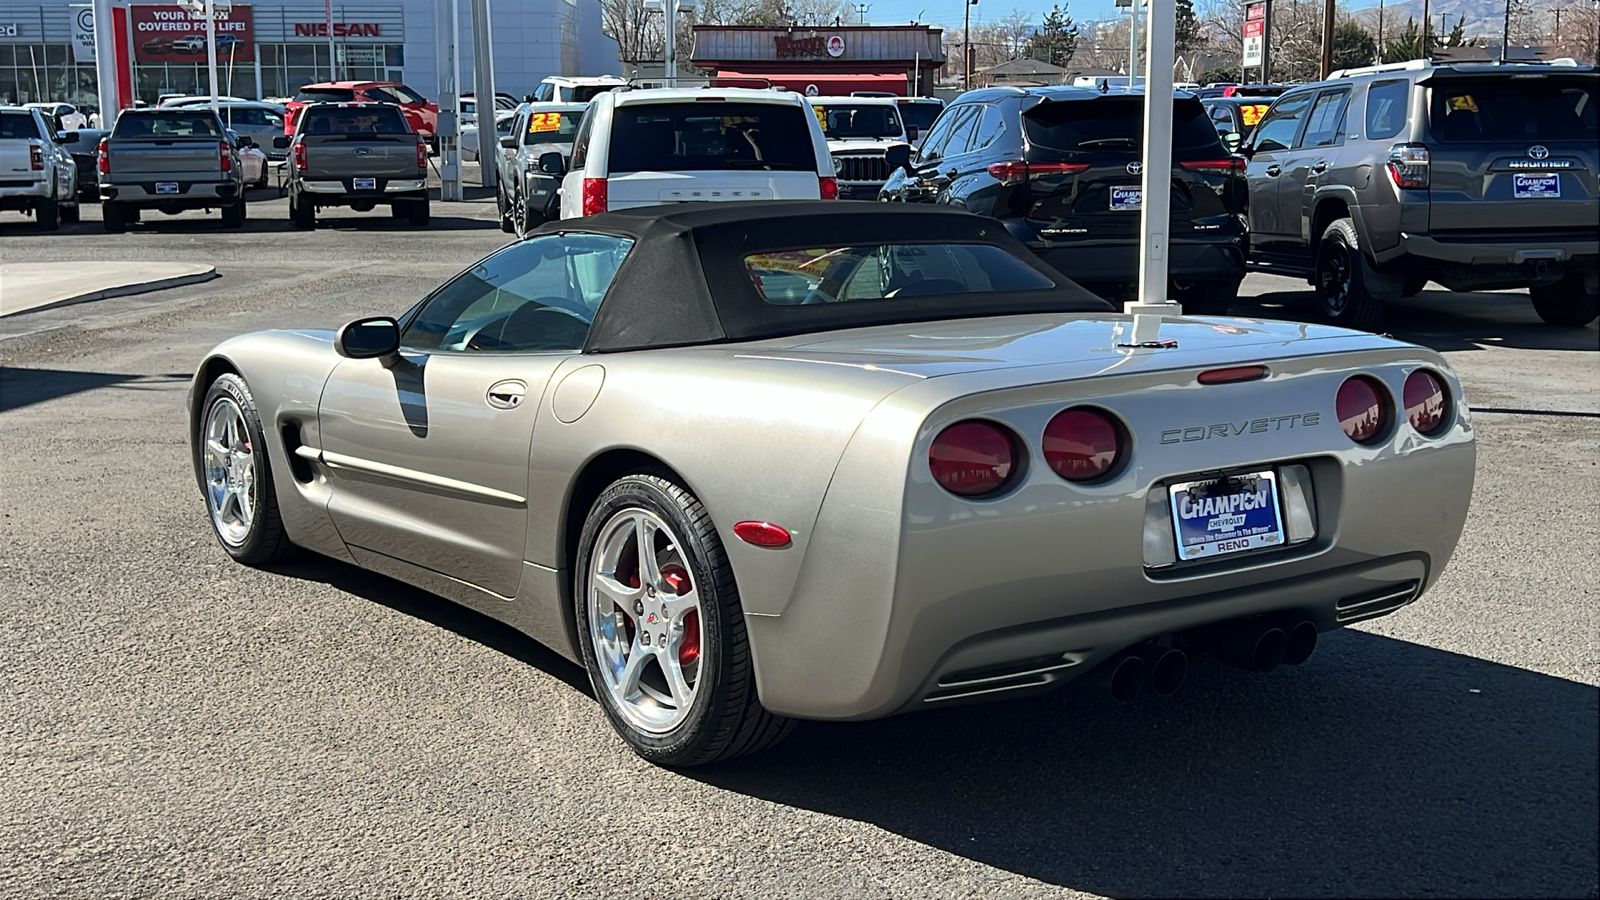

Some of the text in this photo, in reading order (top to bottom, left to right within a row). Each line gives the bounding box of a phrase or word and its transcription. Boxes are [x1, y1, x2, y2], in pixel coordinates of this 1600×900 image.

[153, 11, 185, 20] YOUR
[138, 22, 246, 31] COVERED FO LIFE!
[294, 23, 379, 37] NISSAN
[532, 112, 561, 126] 23
[1517, 178, 1556, 186] CHAMPION
[1159, 411, 1320, 445] CORVETTE
[1180, 490, 1267, 519] CHAMPION
[1209, 516, 1244, 528] CHEVROLET
[1242, 528, 1252, 536] The
[1217, 538, 1250, 552] RENO
